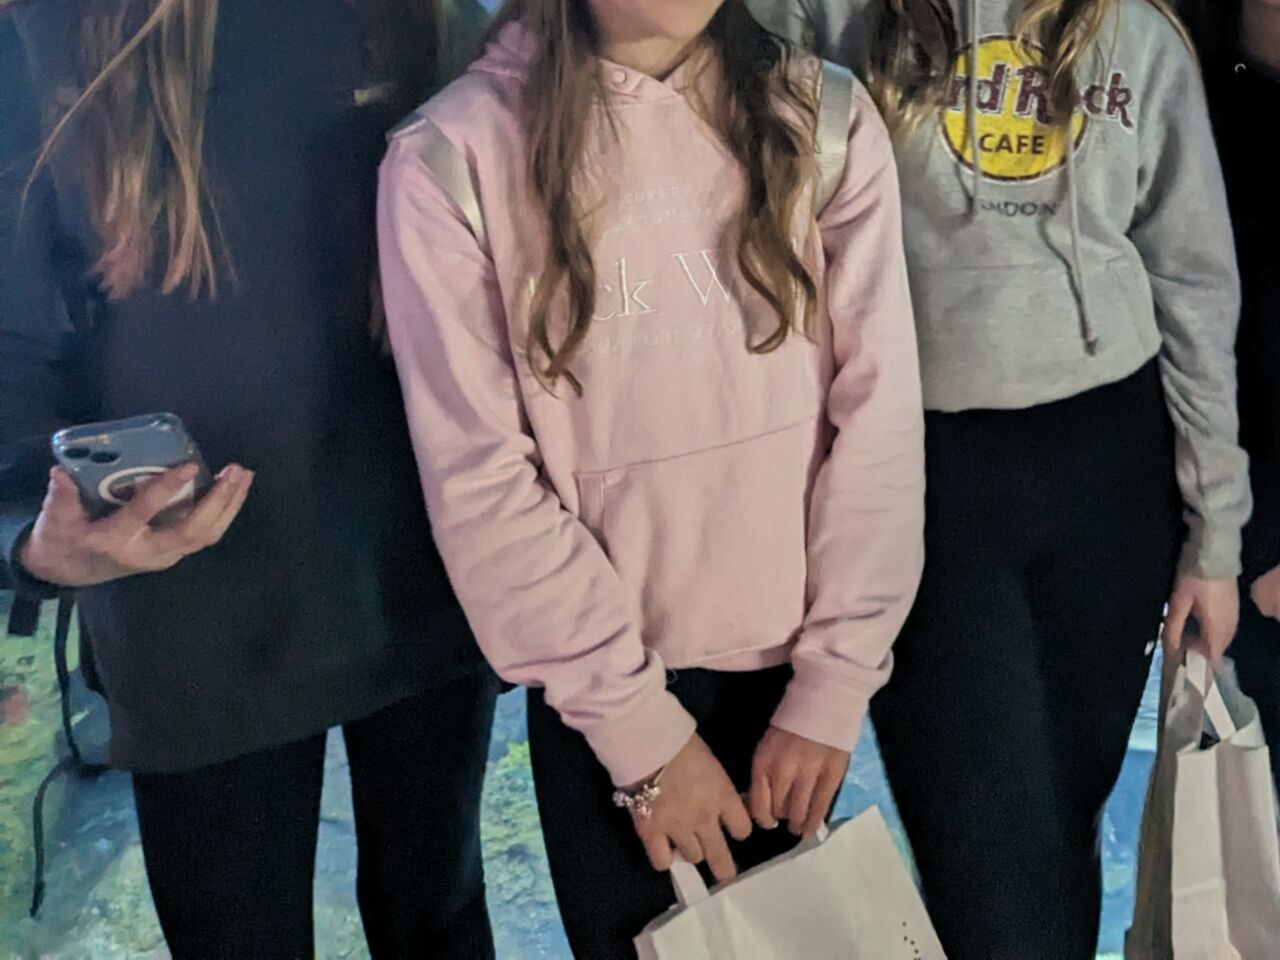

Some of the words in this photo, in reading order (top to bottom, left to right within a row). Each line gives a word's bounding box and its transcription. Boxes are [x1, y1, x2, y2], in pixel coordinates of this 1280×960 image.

[948, 63, 1008, 113] rd
[1015, 63, 1134, 129] Rck
[978, 132, 1045, 155] CAFE
